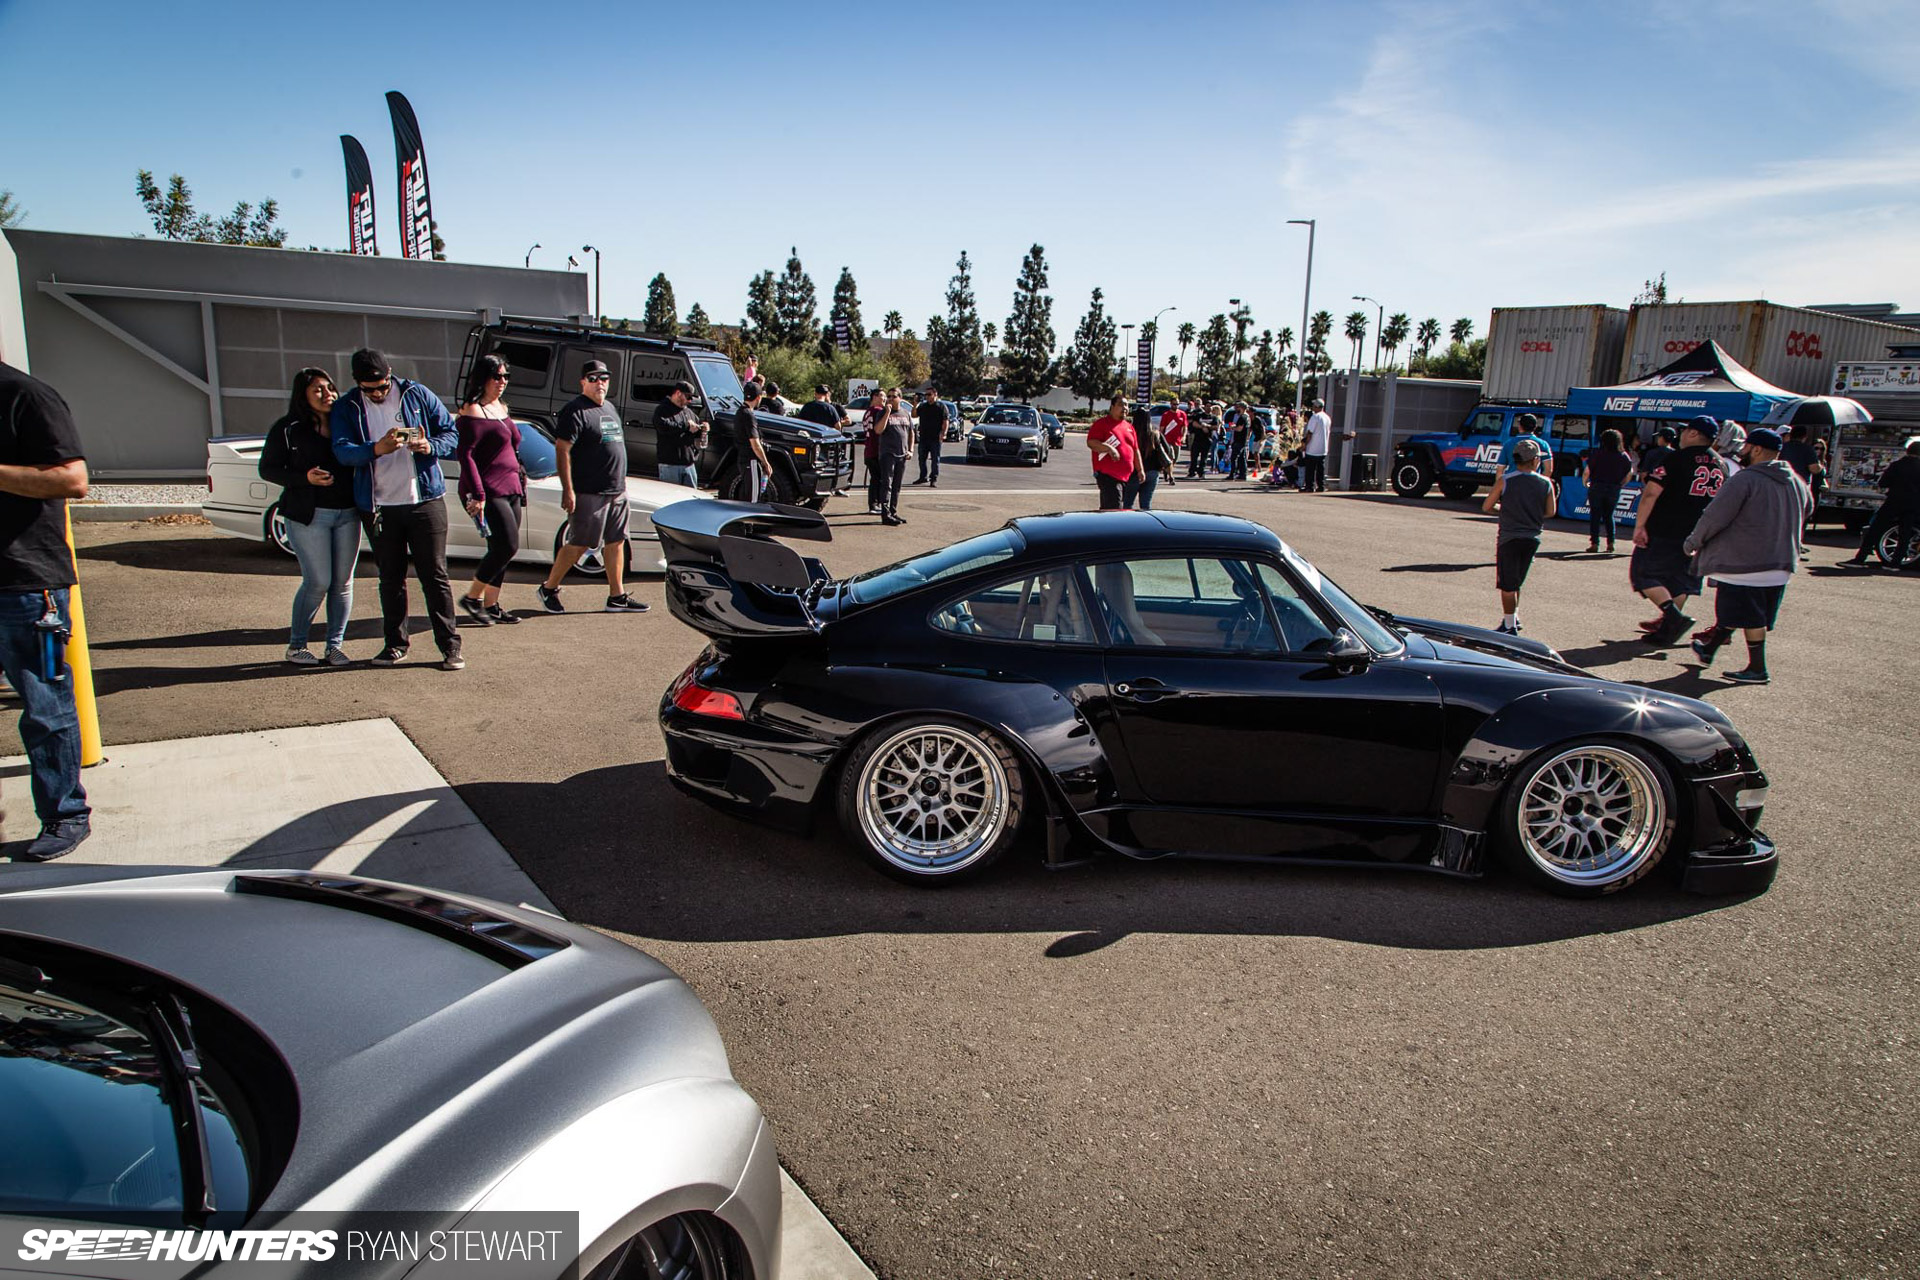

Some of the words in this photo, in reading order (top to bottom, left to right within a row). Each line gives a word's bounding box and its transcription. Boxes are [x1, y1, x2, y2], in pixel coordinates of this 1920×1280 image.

[1640, 370, 1714, 385] NOS
[1603, 397, 1638, 411] NOS
[1640, 398, 1656, 406] HIGH
[1656, 398, 1706, 408] PERFORMANCE
[1474, 444, 1504, 462] NO
[1688, 466, 1725, 497] 23
[1574, 506, 1591, 514] HIGH
